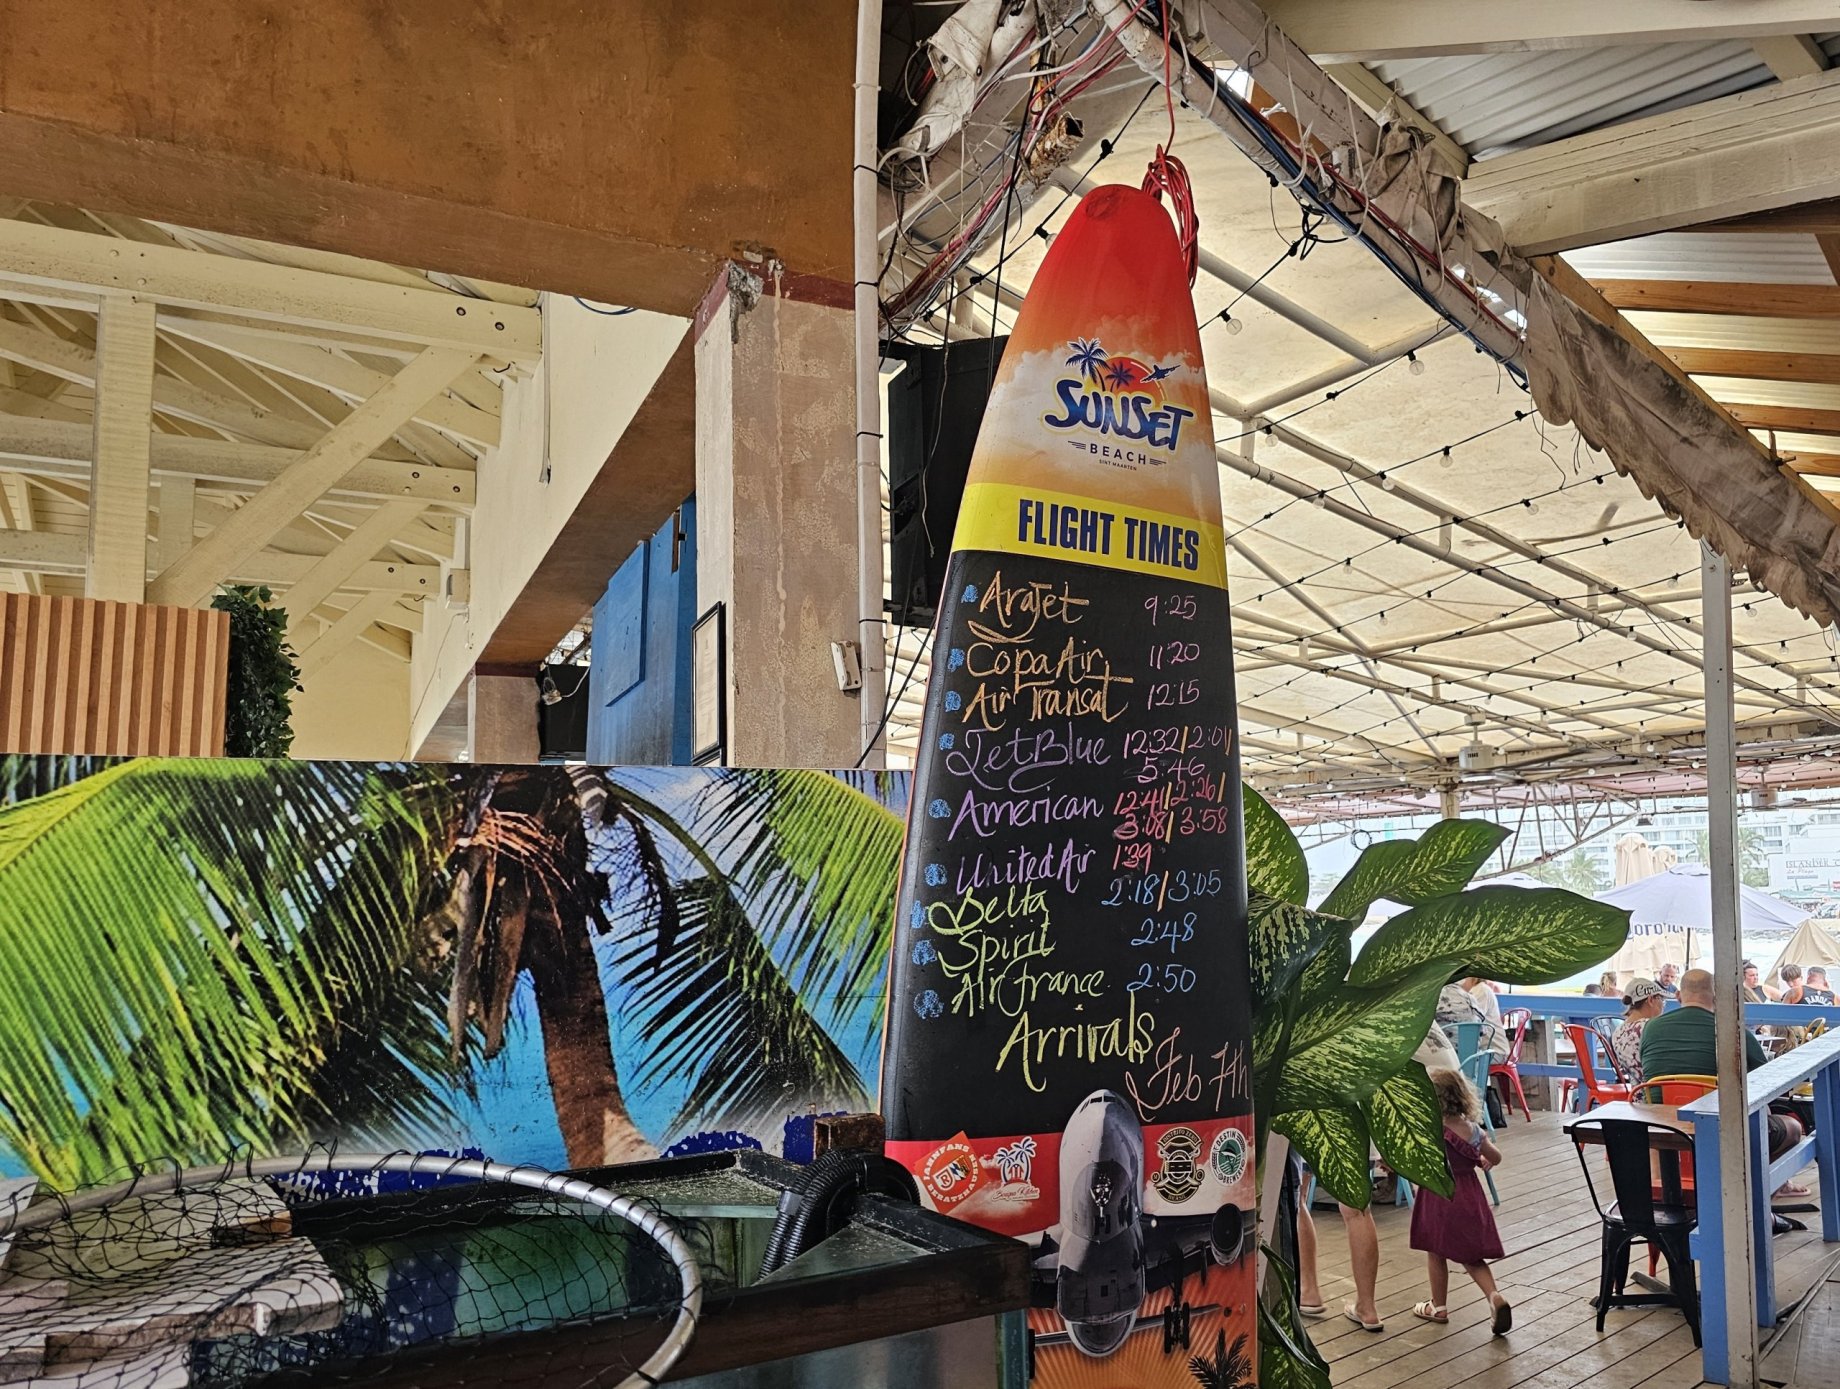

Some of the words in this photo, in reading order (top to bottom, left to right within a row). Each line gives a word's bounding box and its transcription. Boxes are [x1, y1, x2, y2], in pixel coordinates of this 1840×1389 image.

[1044, 379, 1194, 451] SUNSET
[1090, 443, 1147, 465] BEACH
[1018, 498, 1115, 556] FLIGHT
[1124, 517, 1200, 572] TIMES
[1144, 594, 1198, 626] 9:25
[966, 641, 1056, 692] Copa
[1149, 640, 1201, 670] 11:20
[961, 682, 1016, 732] Air
[1147, 678, 1201, 711] 12:15
[947, 785, 1105, 842] American
[1112, 842, 1153, 876] 1:39
[926, 880, 1050, 936] Delta
[1130, 911, 1198, 954] 2:48
[937, 919, 1057, 983] Spirit
[1126, 962, 1197, 994] 2:50
[994, 990, 1156, 1093] Arrivals
[1125, 1026, 1202, 1123] Feb
[1215, 1130, 1237, 1147] DESTIN
